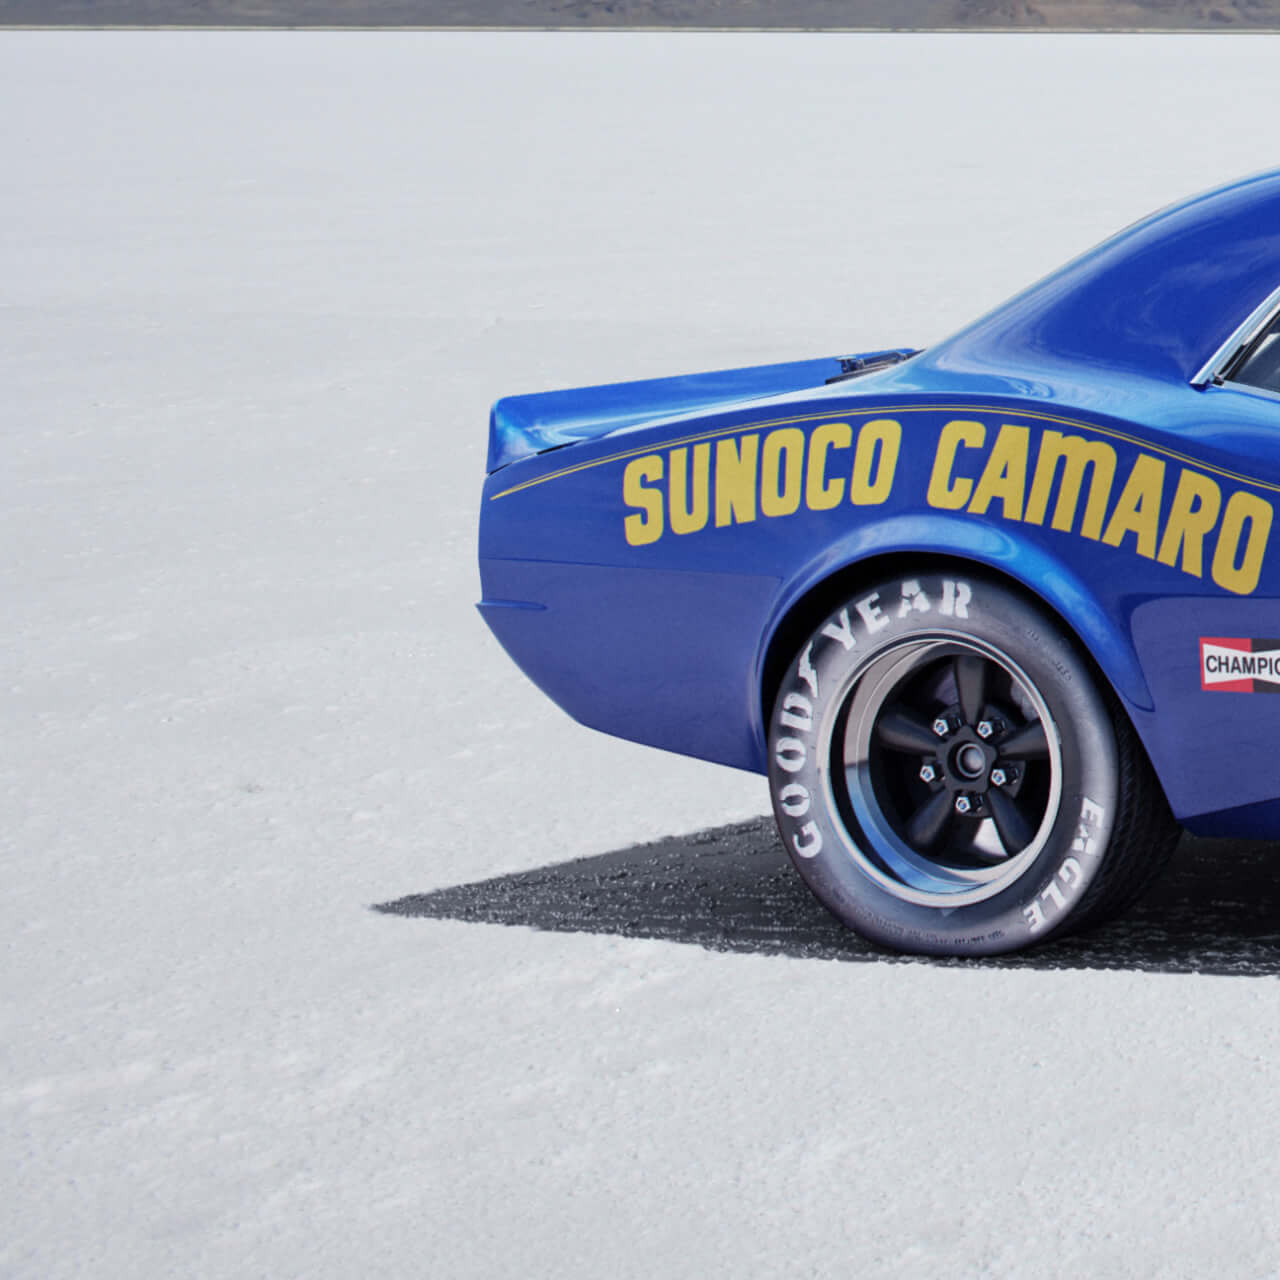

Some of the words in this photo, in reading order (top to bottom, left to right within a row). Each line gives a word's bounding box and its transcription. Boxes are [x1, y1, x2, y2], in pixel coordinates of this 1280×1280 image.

[623, 419, 902, 546] SUNOCO
[926, 419, 1274, 595] CAMARO
[1023, 797, 1105, 933] EAGLE
